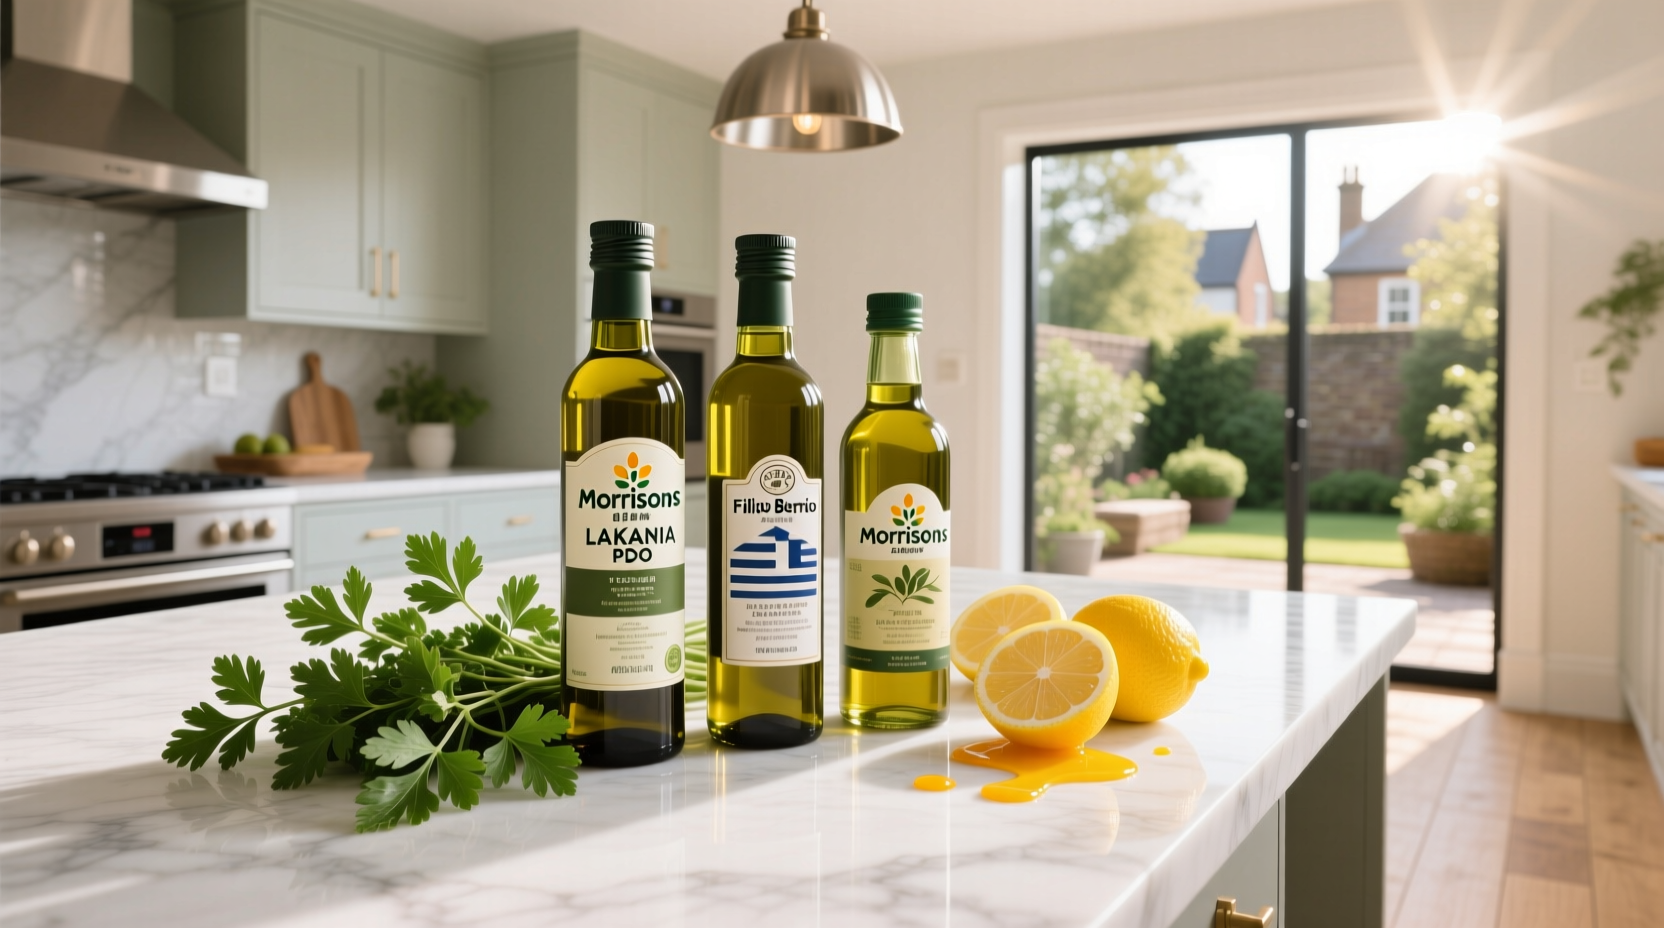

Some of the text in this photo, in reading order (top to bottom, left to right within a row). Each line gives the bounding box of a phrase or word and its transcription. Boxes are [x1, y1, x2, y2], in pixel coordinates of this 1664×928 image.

[578, 486, 681, 509] Morrisons
[586, 525, 676, 546] LAKANIA
[860, 525, 948, 545] Morrisons
[612, 547, 653, 563] PDO
